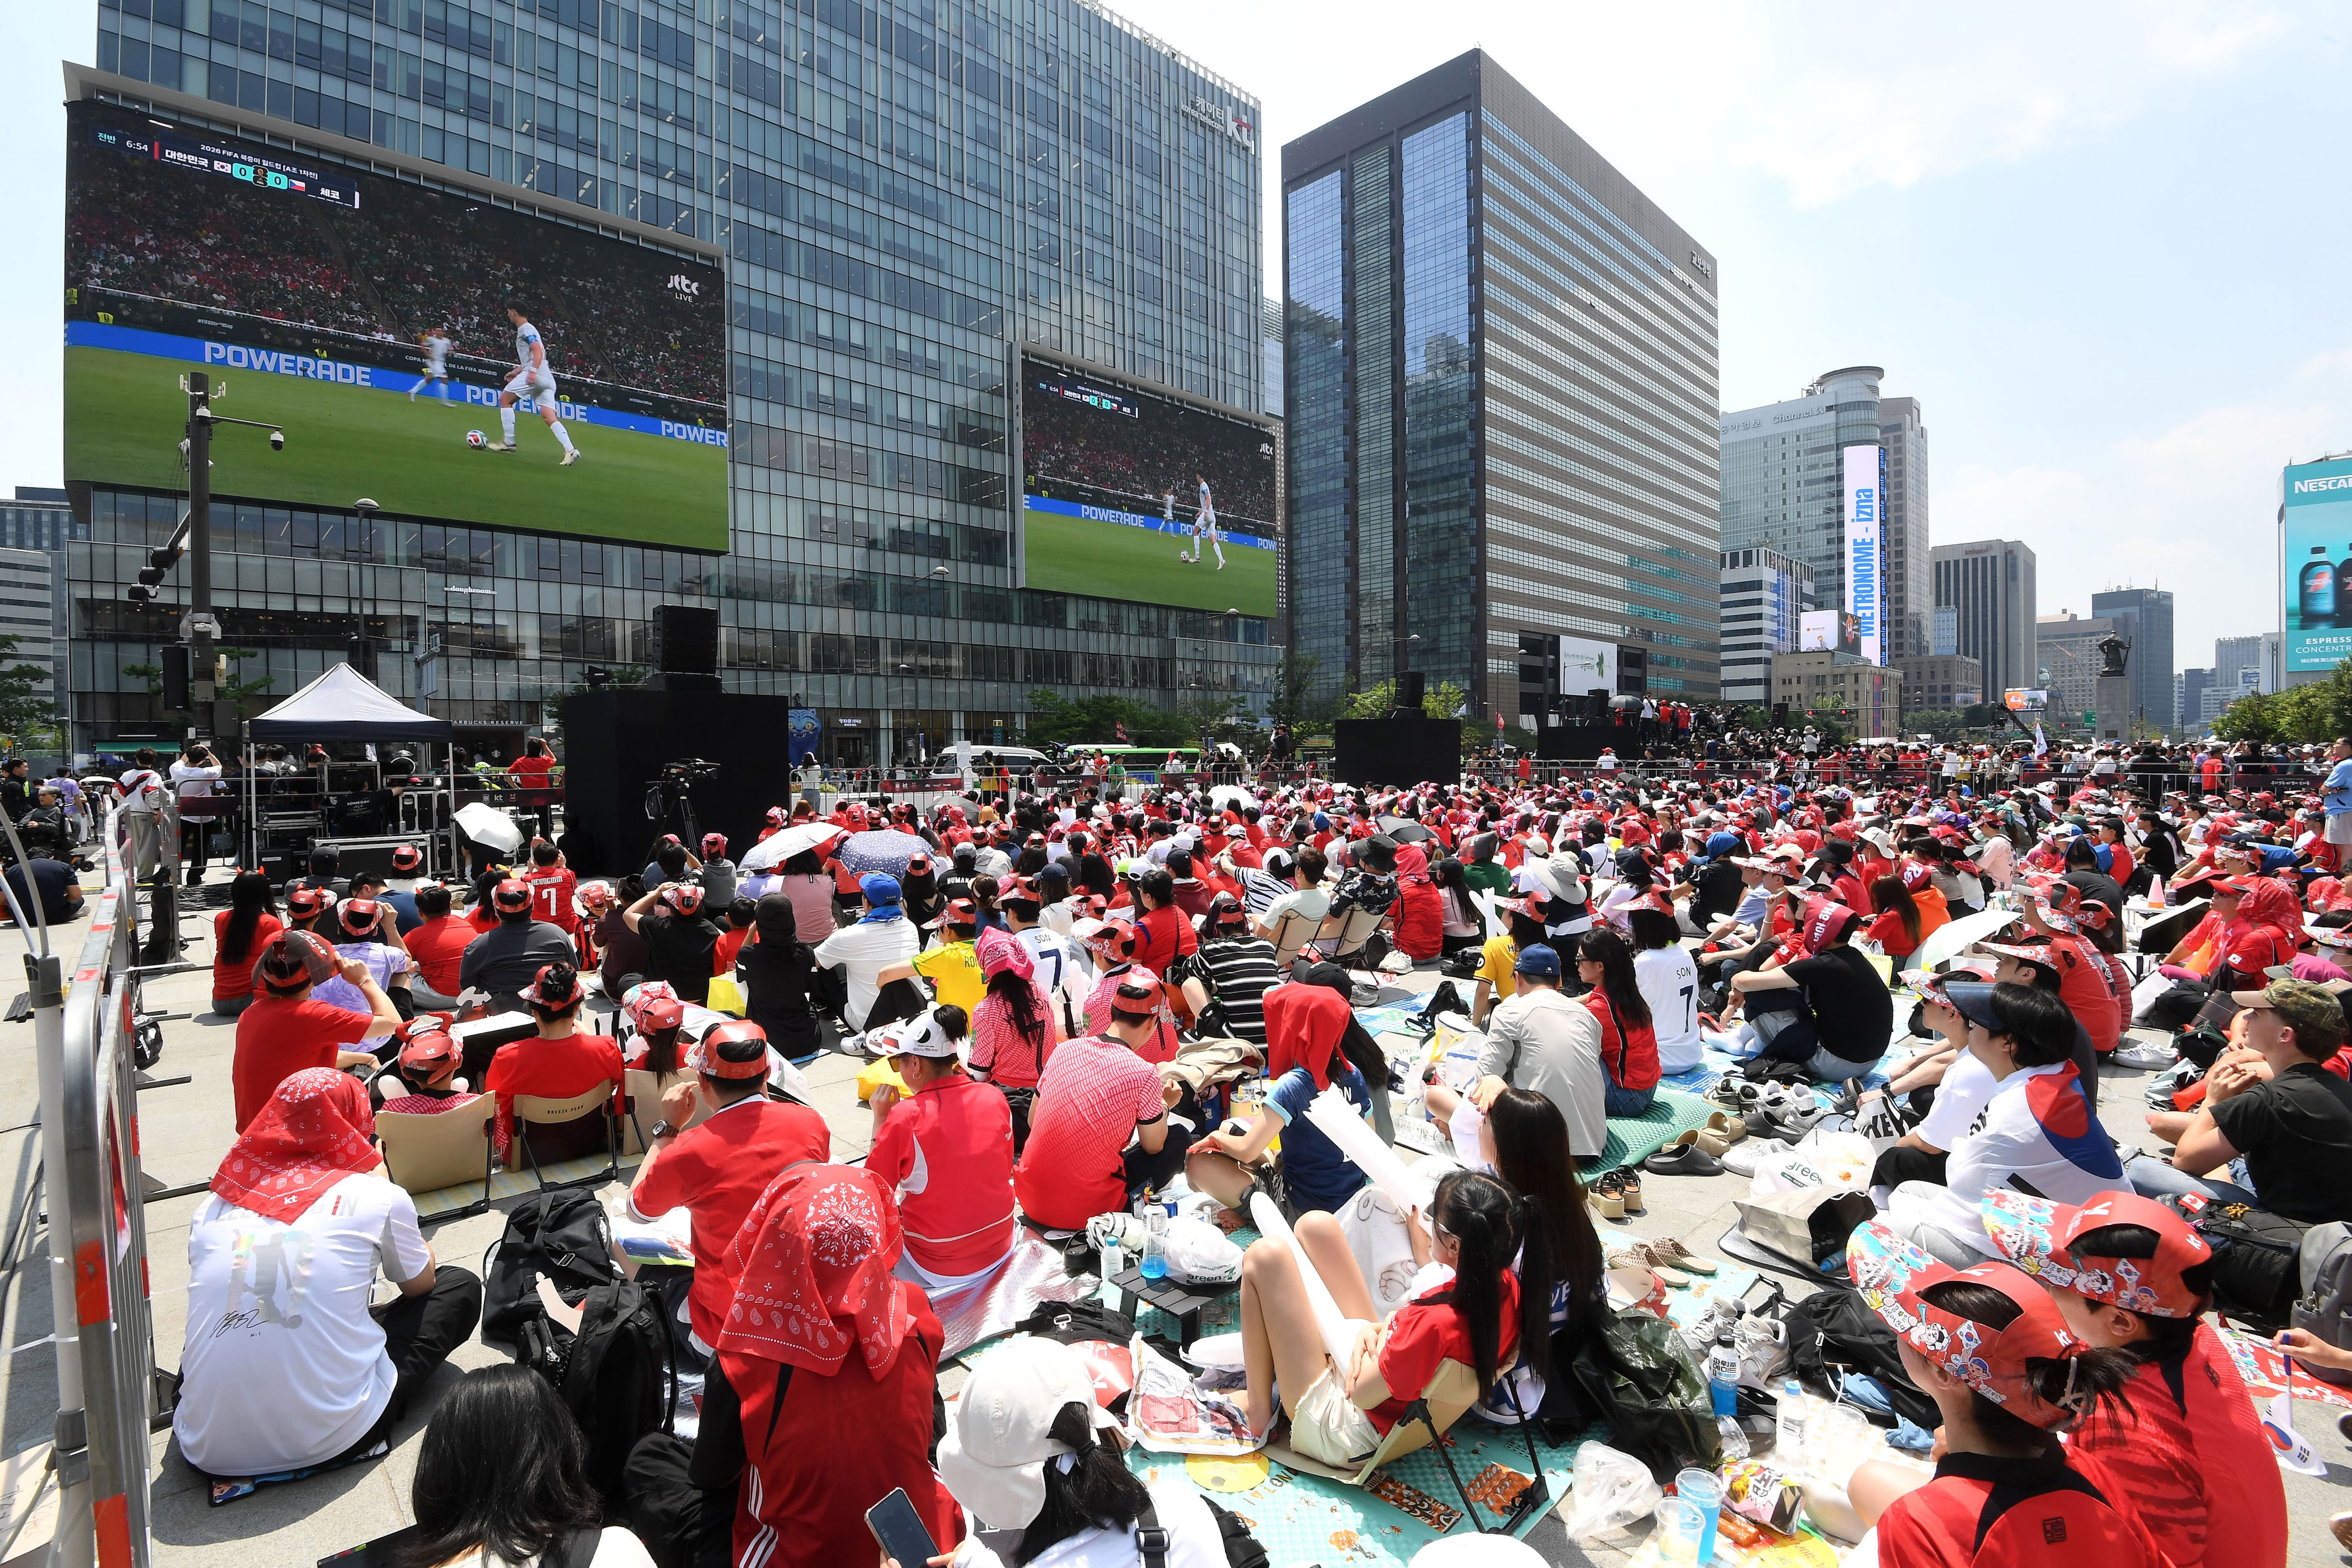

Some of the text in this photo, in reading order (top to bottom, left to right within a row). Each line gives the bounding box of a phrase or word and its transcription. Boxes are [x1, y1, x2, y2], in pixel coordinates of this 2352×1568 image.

[1181, 101, 1224, 133] korea telecom
[1226, 106, 1252, 148] kt
[98, 132, 149, 152] 전반 6:54
[165, 149, 209, 168] 대한민국
[200, 144, 318, 180] 2026 FIFA 북중미 월드컵 [A조 1차전]
[239, 167, 247, 176] 0
[274, 176, 282, 186] 0
[320, 187, 341, 200] 체코
[667, 273, 700, 296] jtbc
[675, 292, 693, 303] LIVE
[205, 341, 372, 387] POWERADE
[405, 355, 421, 363] COPA
[478, 369, 497, 377] 2026
[1772, 408, 1813, 424] Channel
[1720, 419, 1761, 434] 동아일보
[1851, 488, 1874, 523] izna
[1081, 504, 1145, 528] POWERADE
[451, 585, 491, 594] doughroom
[1853, 537, 1874, 636] METRONOME
[2306, 636, 2352, 645] ESPRESS
[541, 886, 557, 916] 7
[1034, 934, 1051, 943] SON
[1038, 948, 1062, 992] 7
[1676, 966, 1692, 980] SON
[1679, 985, 1693, 1033] 7
[284, 1194, 298, 1205] kt
[2185, 1233, 2202, 1250] kt
[1187, 1273, 1224, 1283] green
[2053, 1328, 2071, 1347] kt
